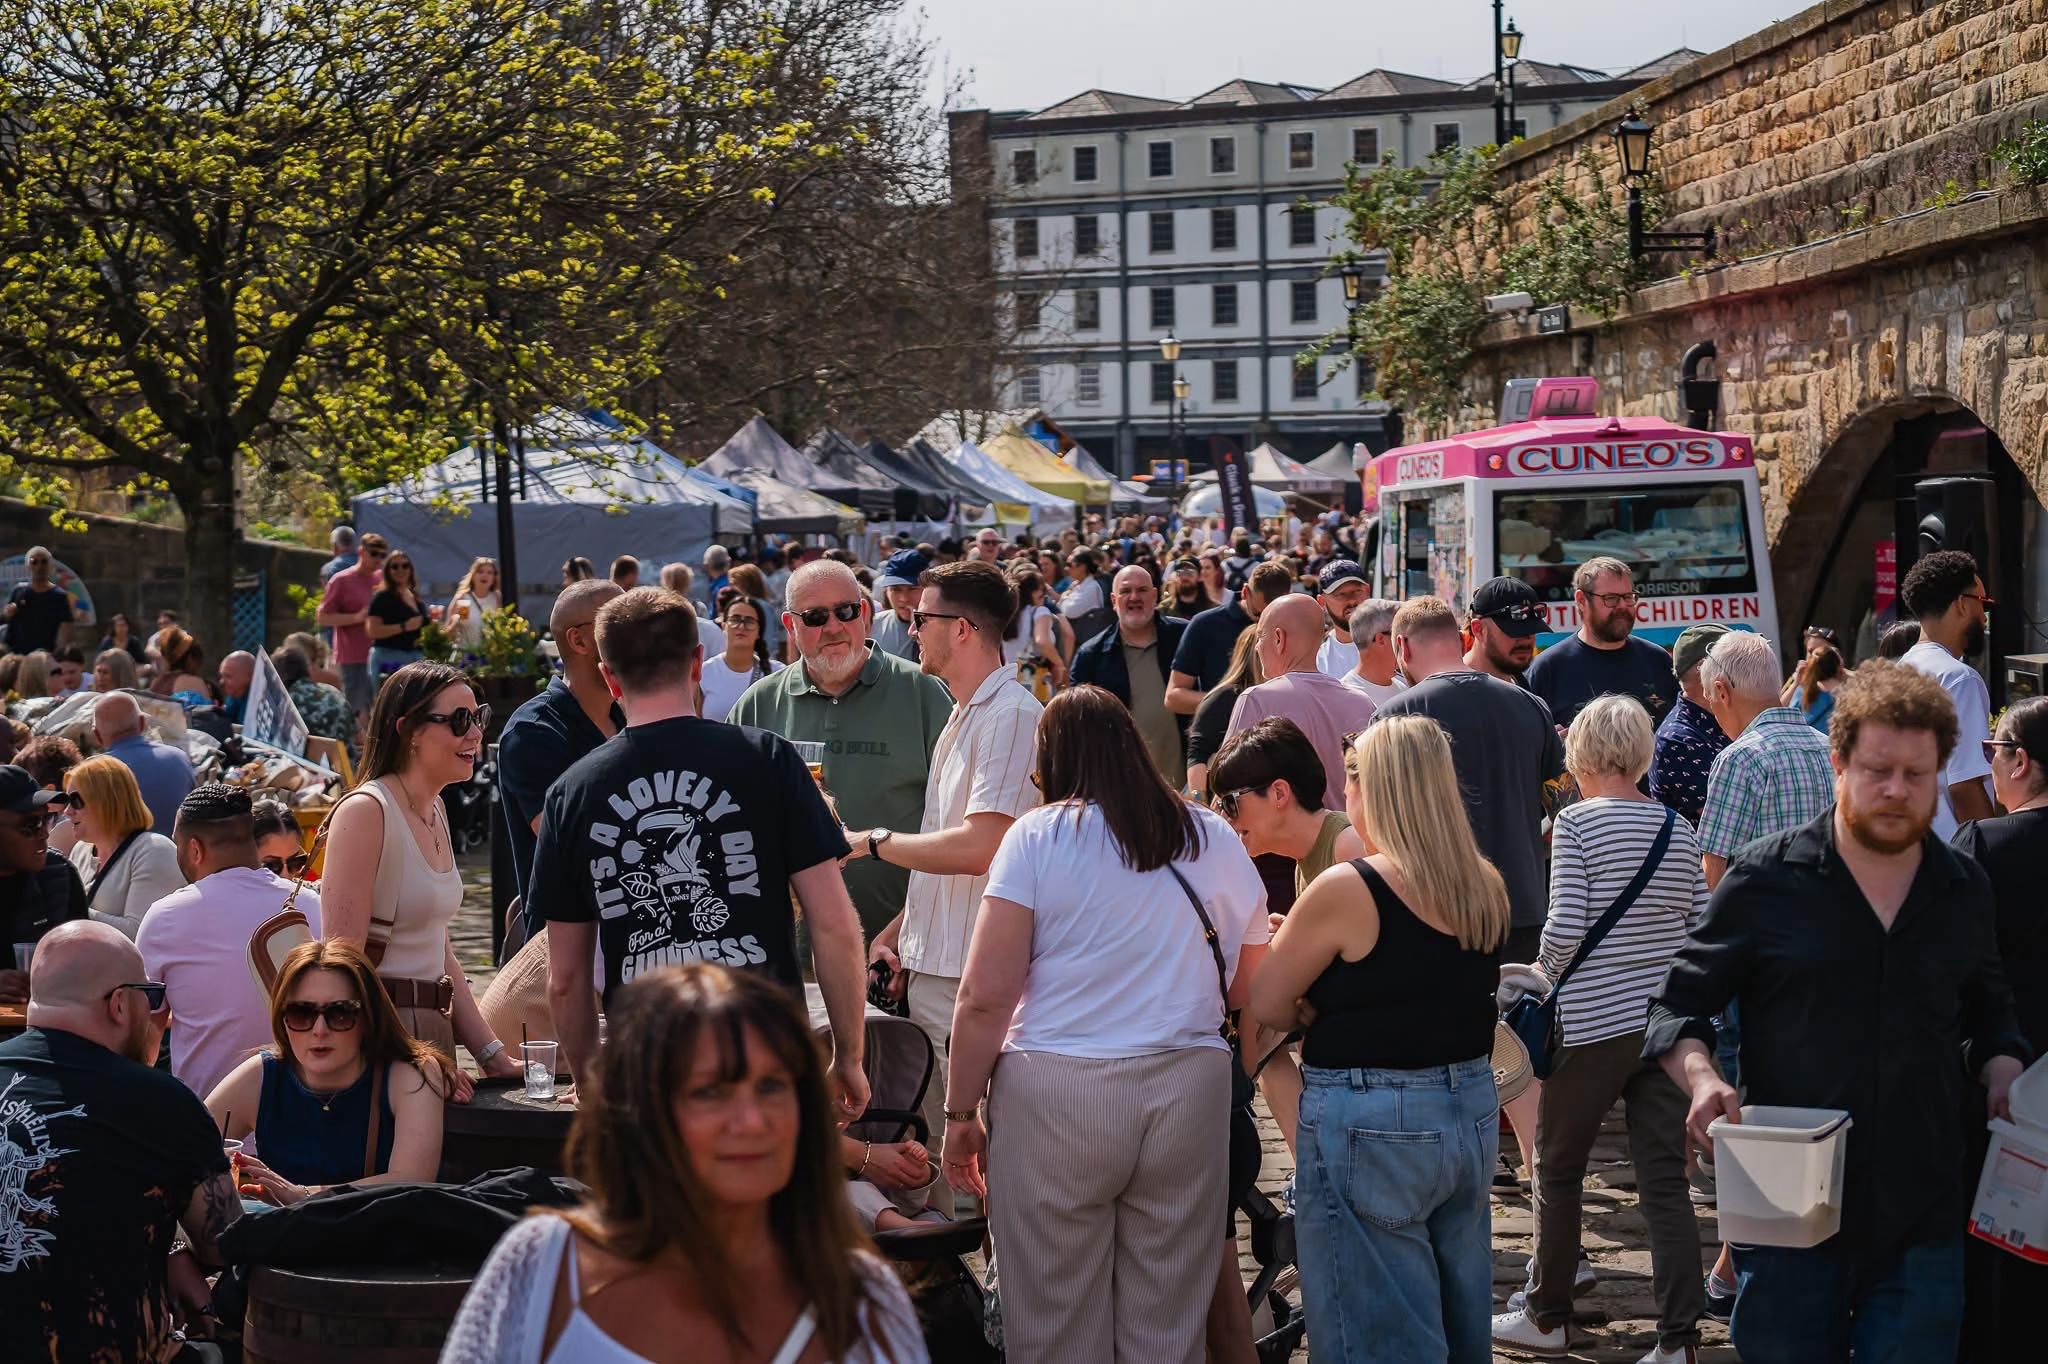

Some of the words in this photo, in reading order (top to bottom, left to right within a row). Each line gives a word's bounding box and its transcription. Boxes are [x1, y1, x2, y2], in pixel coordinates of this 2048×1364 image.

[1400, 454, 1440, 480] CUNEO'S
[1518, 440, 1713, 473] CUNEO'S
[1634, 581, 1701, 595] ORRISON
[1636, 597, 1759, 623] CHILDREN
[608, 770, 741, 823] LOVELY
[589, 822, 621, 848] A
[720, 830, 761, 897] DAY
[590, 856, 629, 920] IT'S
[628, 929, 653, 953] For
[655, 926, 666, 937] a
